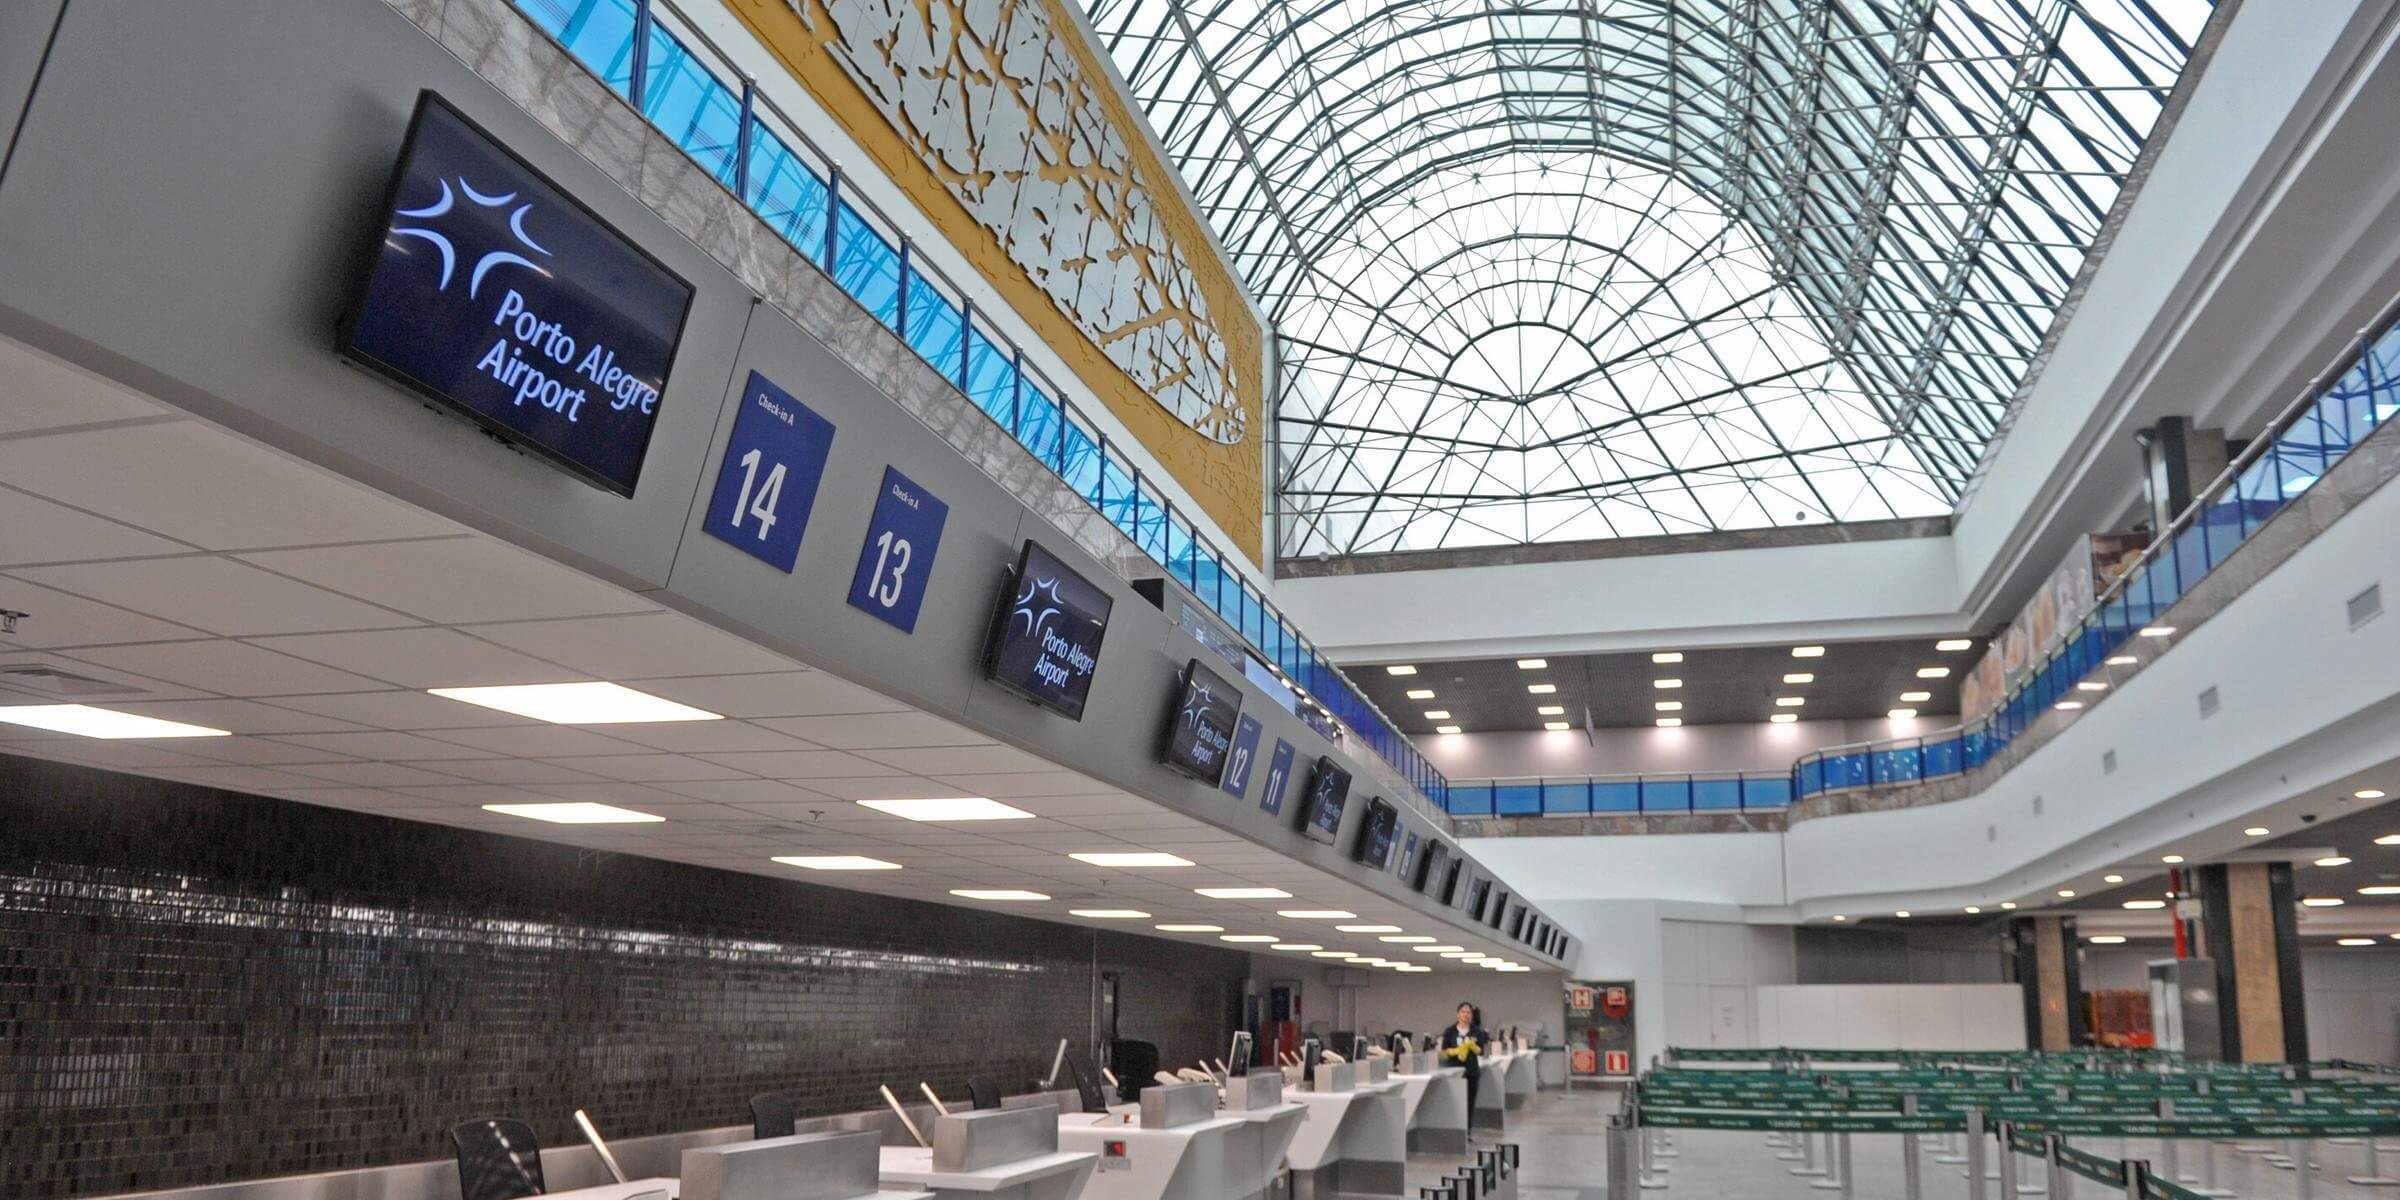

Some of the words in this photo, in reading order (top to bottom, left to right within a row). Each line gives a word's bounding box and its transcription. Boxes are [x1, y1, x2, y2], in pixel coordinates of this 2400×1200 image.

[494, 289, 576, 365] Porto
[576, 344, 658, 414] Alegre
[477, 339, 586, 422] Airport
[758, 393, 788, 422] Check-in
[787, 413, 794, 426] A
[731, 448, 787, 541] 14
[892, 484, 913, 507] Check-in
[868, 530, 912, 608] 13
[1033, 653, 1070, 688] Airport
[1041, 626, 1068, 659] Porto
[1067, 642, 1094, 676] Alegre
[1229, 747, 1248, 787] 12
[1266, 769, 1281, 805] 11
